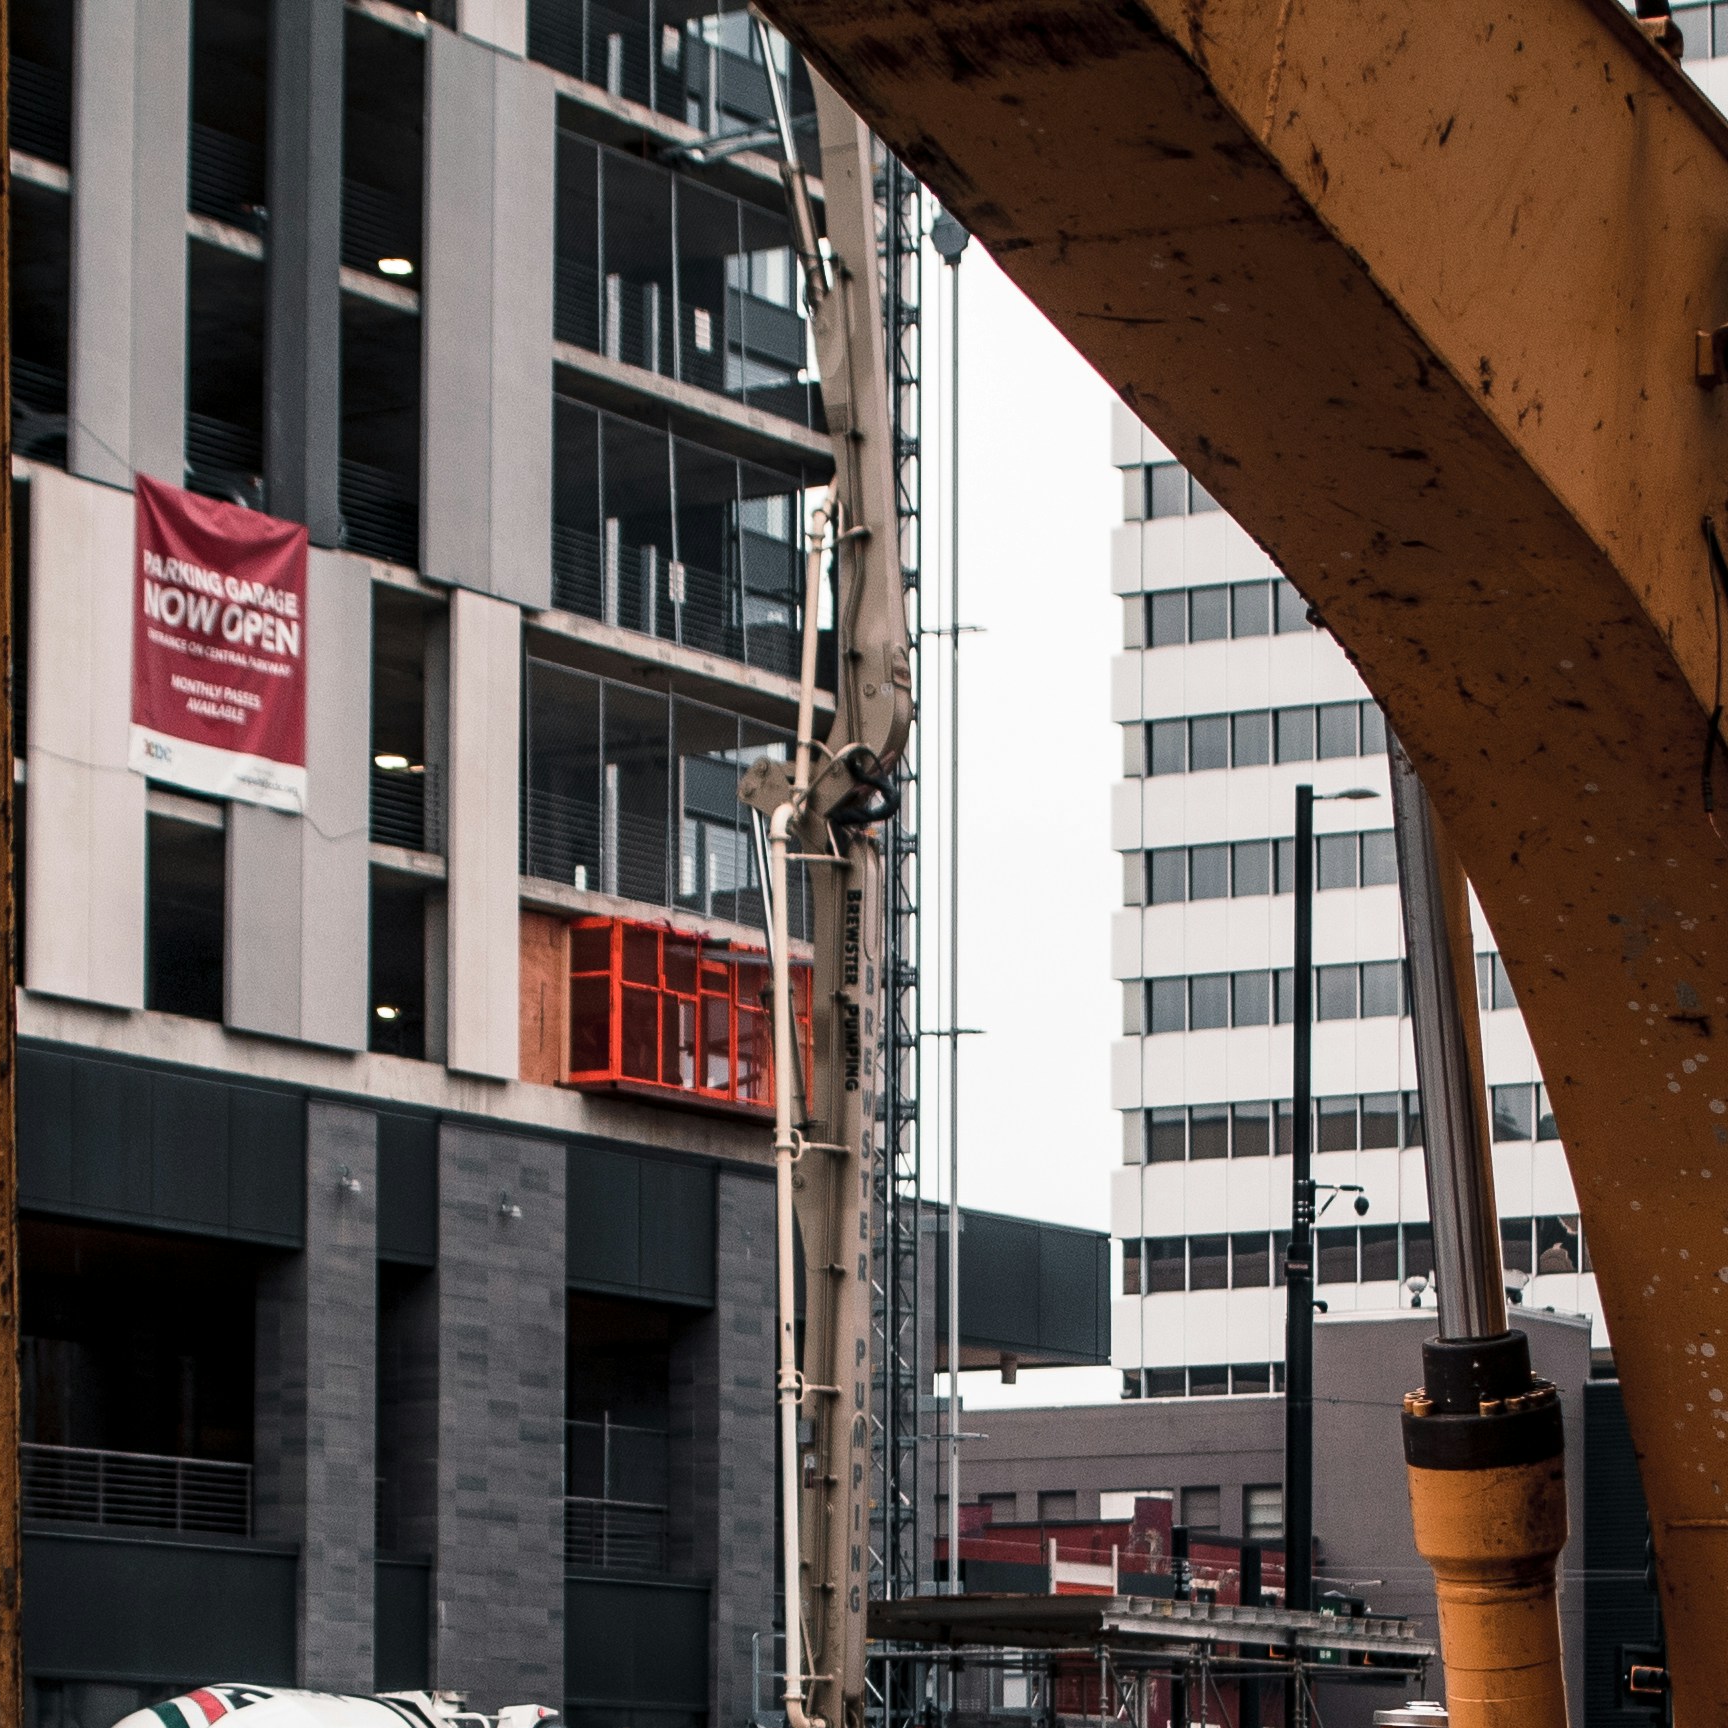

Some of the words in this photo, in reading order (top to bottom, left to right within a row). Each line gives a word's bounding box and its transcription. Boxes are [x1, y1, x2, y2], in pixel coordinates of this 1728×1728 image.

[143, 549, 224, 597] PARKING
[225, 576, 299, 618] GARAGE
[144, 578, 219, 635] NOW
[221, 604, 300, 657] OPEN
[170, 673, 221, 701] MONTHLY
[223, 687, 262, 711] PASSES
[186, 696, 246, 725] AVAILABLE
[844, 889, 862, 985] BREWSTER
[843, 1003, 860, 1092] PUMPING
[849, 1337, 867, 1613] PUMPING
